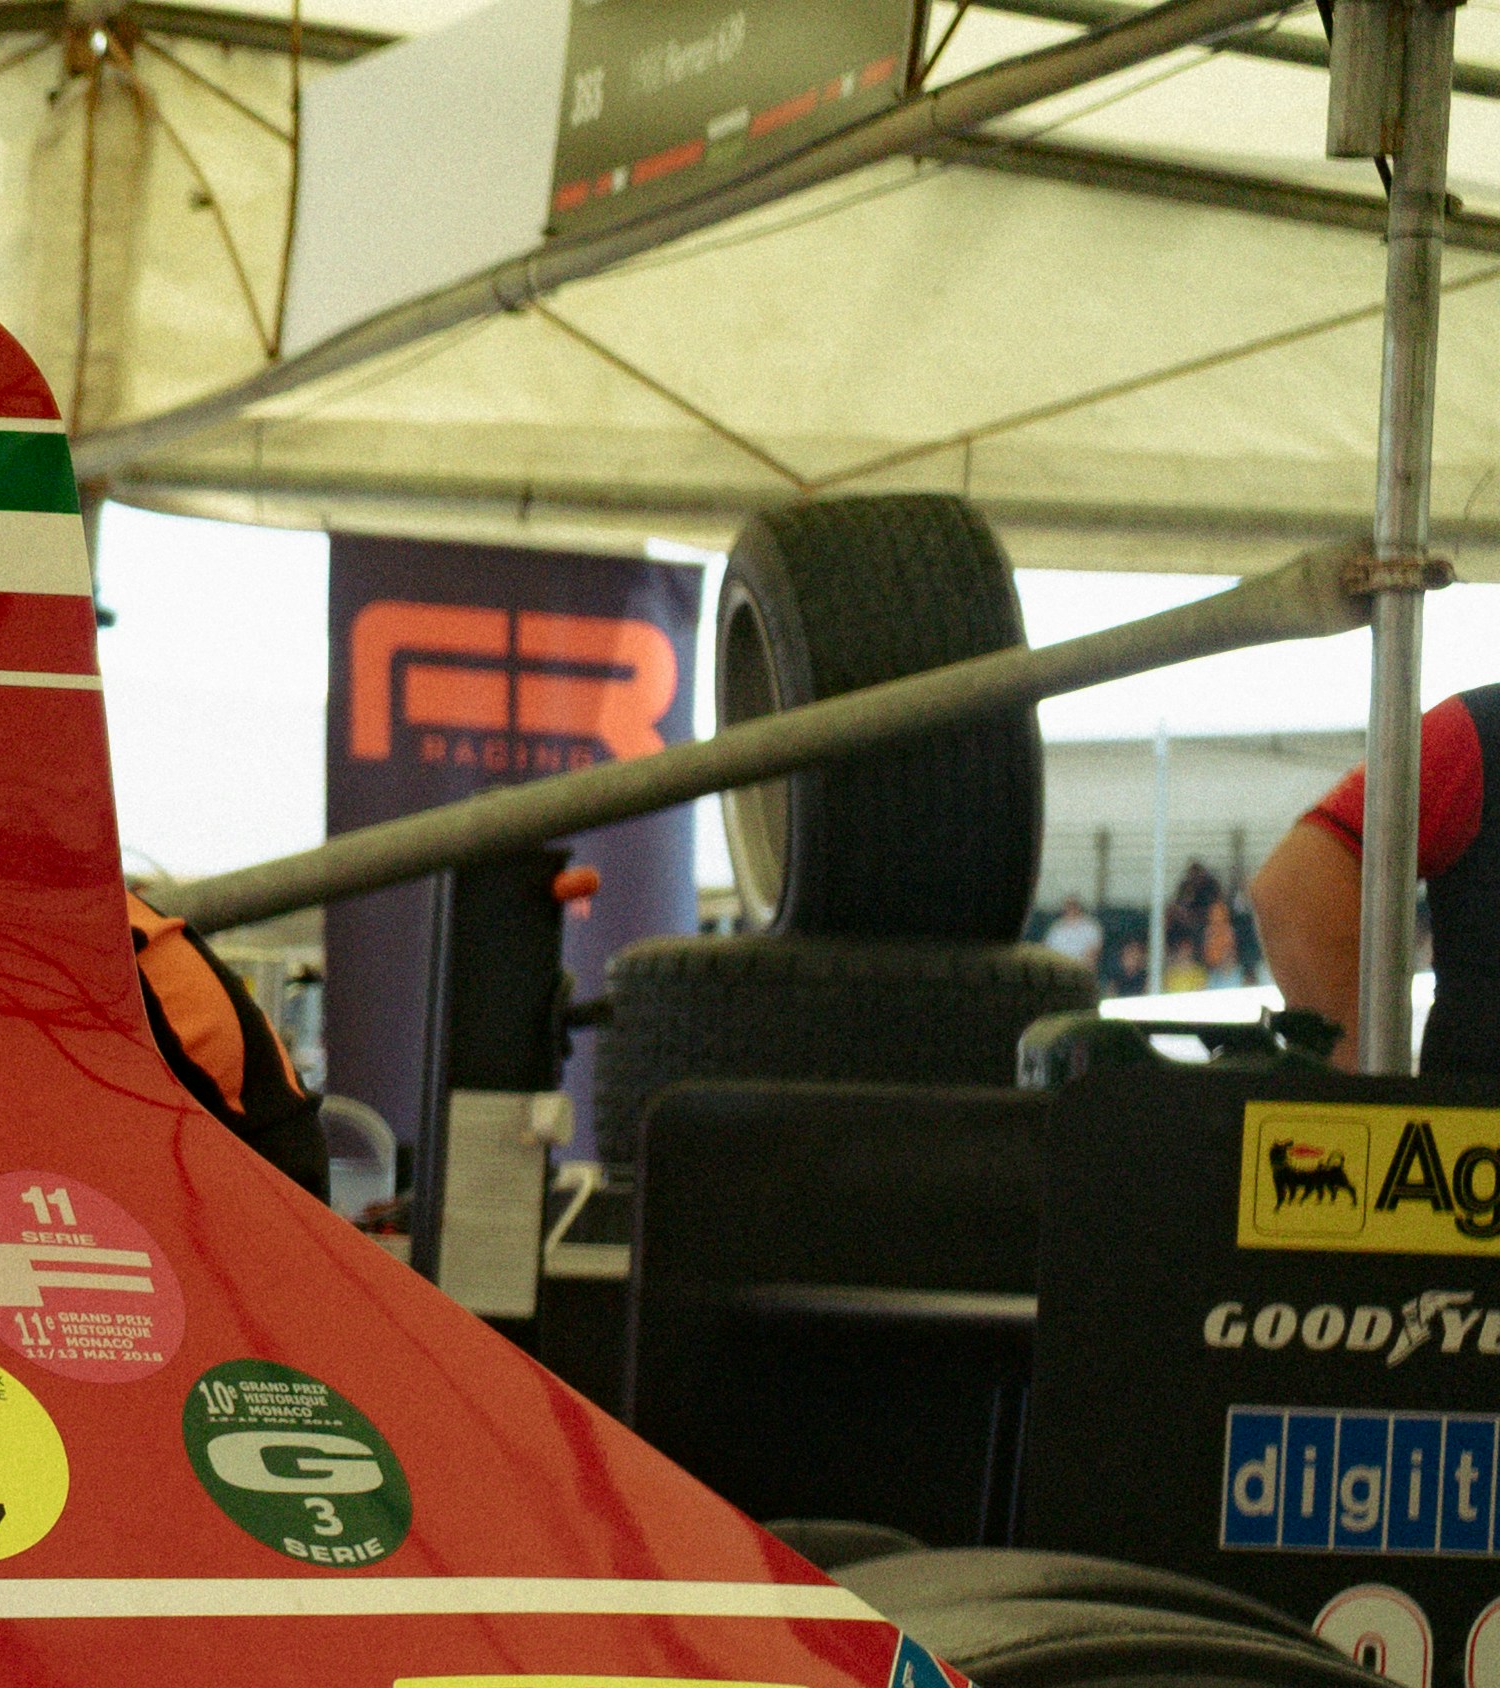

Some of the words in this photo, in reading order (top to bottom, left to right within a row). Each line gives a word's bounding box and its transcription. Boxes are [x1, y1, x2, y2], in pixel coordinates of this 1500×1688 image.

[21, 1185, 77, 1226] 11
[21, 1230, 96, 1247] SERIE
[57, 1311, 112, 1325] GRAND
[116, 1313, 153, 1327] PRIX
[61, 1324, 152, 1339] HISTORIQUE
[66, 1337, 135, 1349] MONACO
[82, 1349, 118, 1361] MAI
[238, 1381, 290, 1394] GRAND
[292, 1382, 329, 1395] PRIX
[243, 1393, 329, 1408] HISTORIQUE
[248, 1406, 313, 1419] MONACO
[207, 1430, 384, 1494] G
[1232, 1443, 1480, 1532] digit
[304, 1497, 344, 1537] 3
[282, 1537, 385, 1563] SERIE
